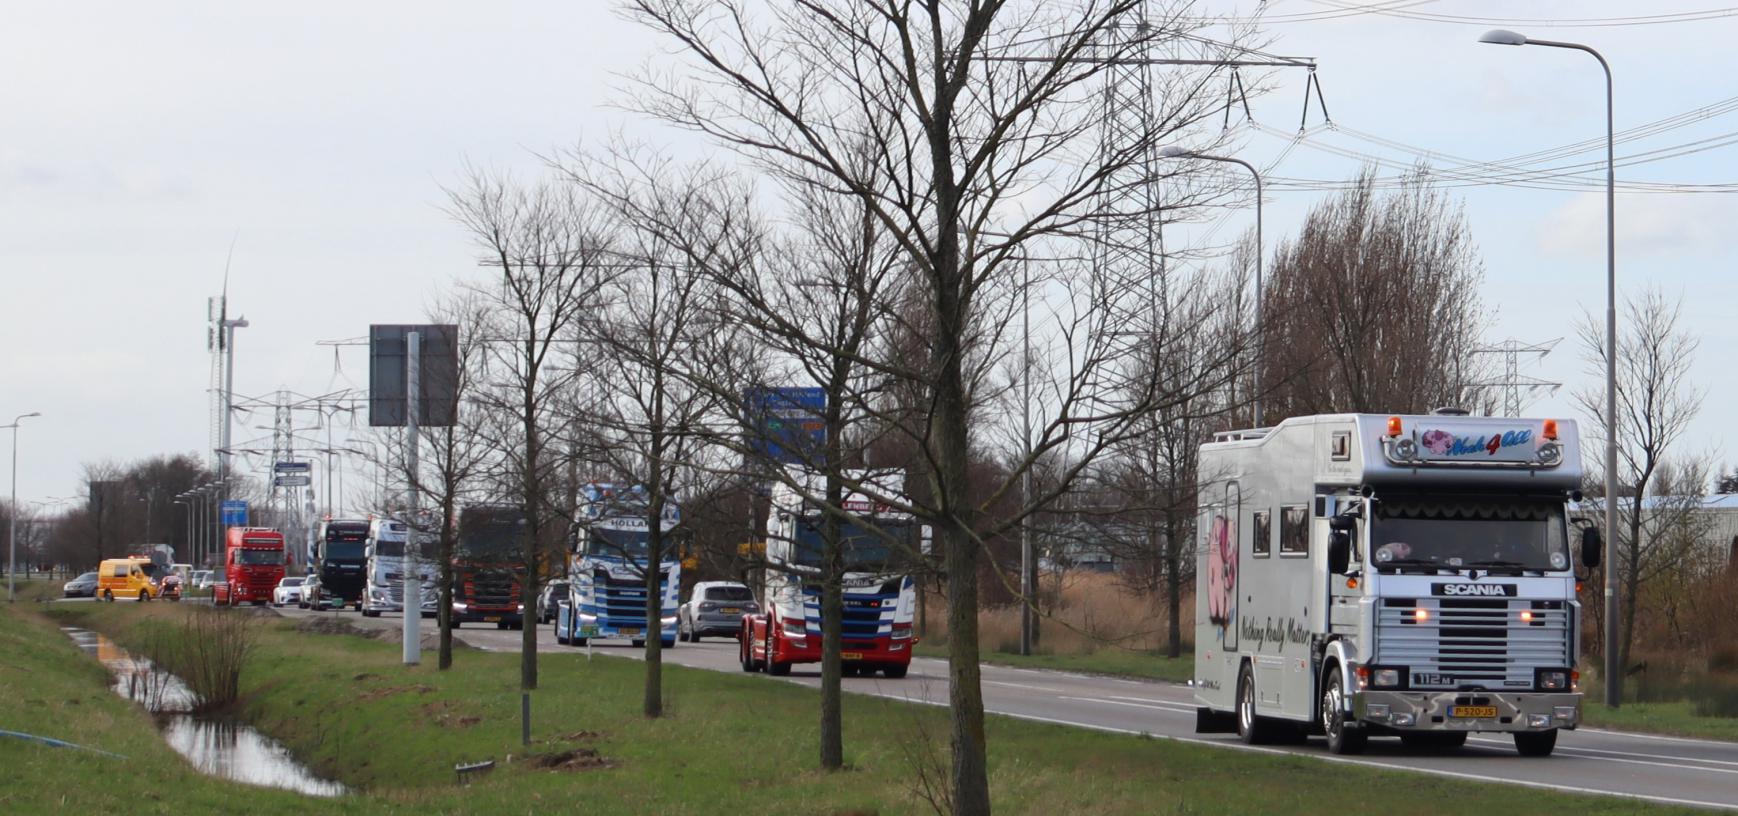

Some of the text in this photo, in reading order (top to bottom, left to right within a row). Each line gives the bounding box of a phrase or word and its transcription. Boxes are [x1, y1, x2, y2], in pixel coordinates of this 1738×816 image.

[1486, 433, 1502, 455] 4
[1444, 584, 1505, 596] SCANIA
[1241, 615, 1264, 652] Nothing
[1265, 615, 1286, 653] Really
